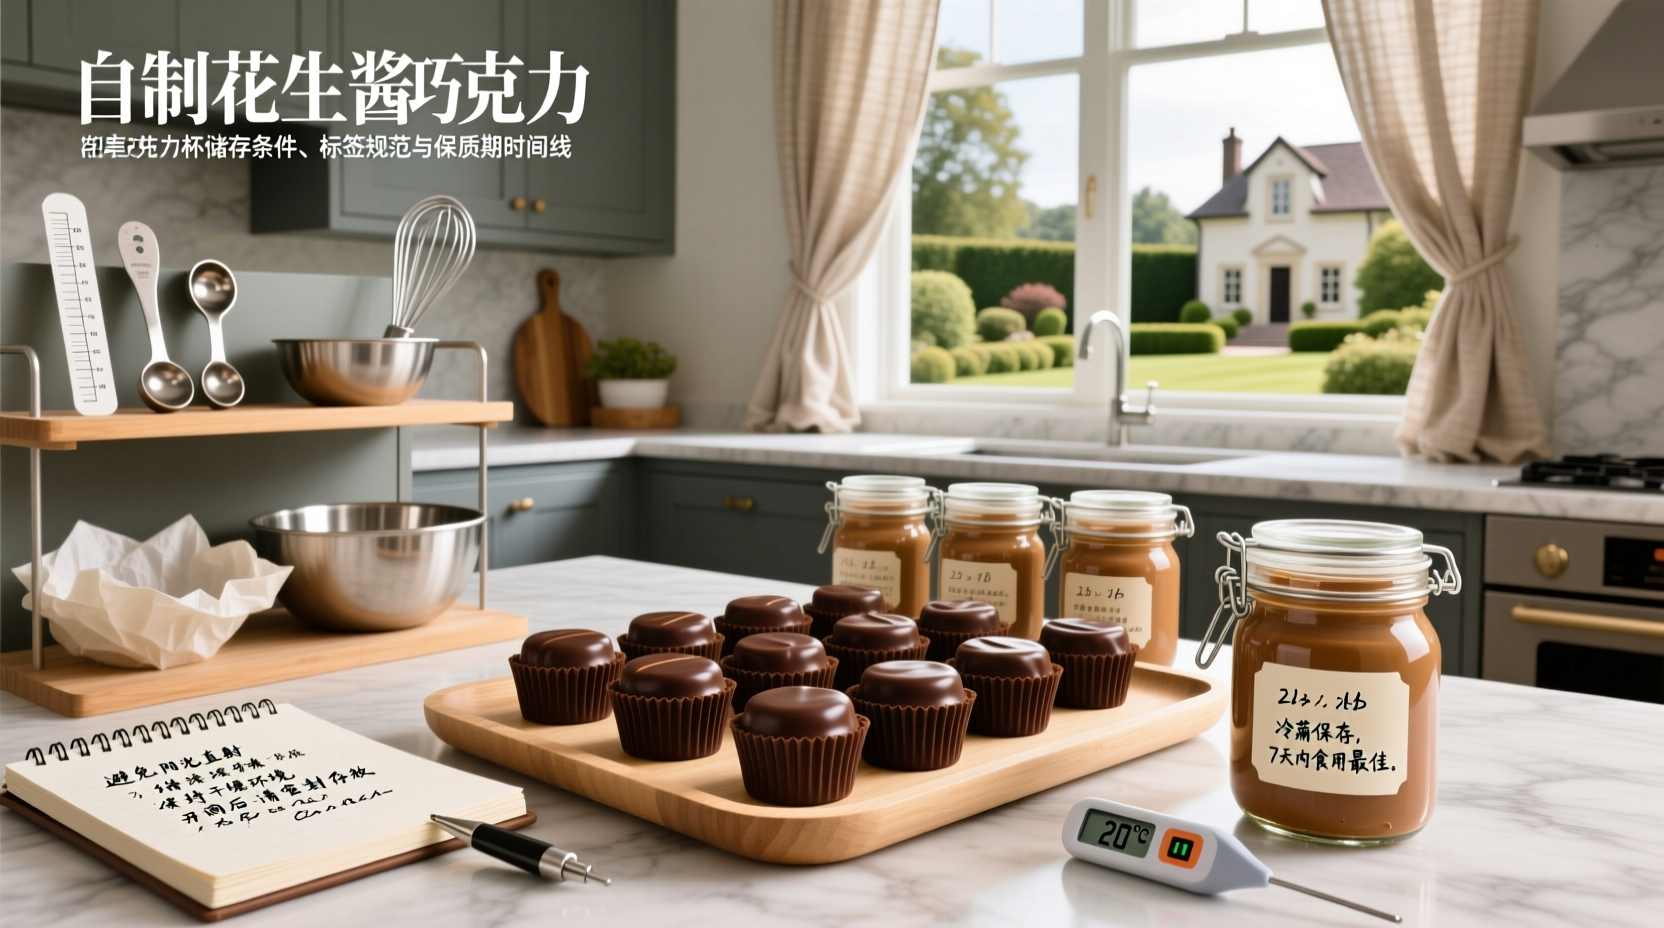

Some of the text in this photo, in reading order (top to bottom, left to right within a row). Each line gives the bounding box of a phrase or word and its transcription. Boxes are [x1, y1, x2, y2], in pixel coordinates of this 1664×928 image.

[1269, 745, 1396, 775] 7天内食用最佳。
